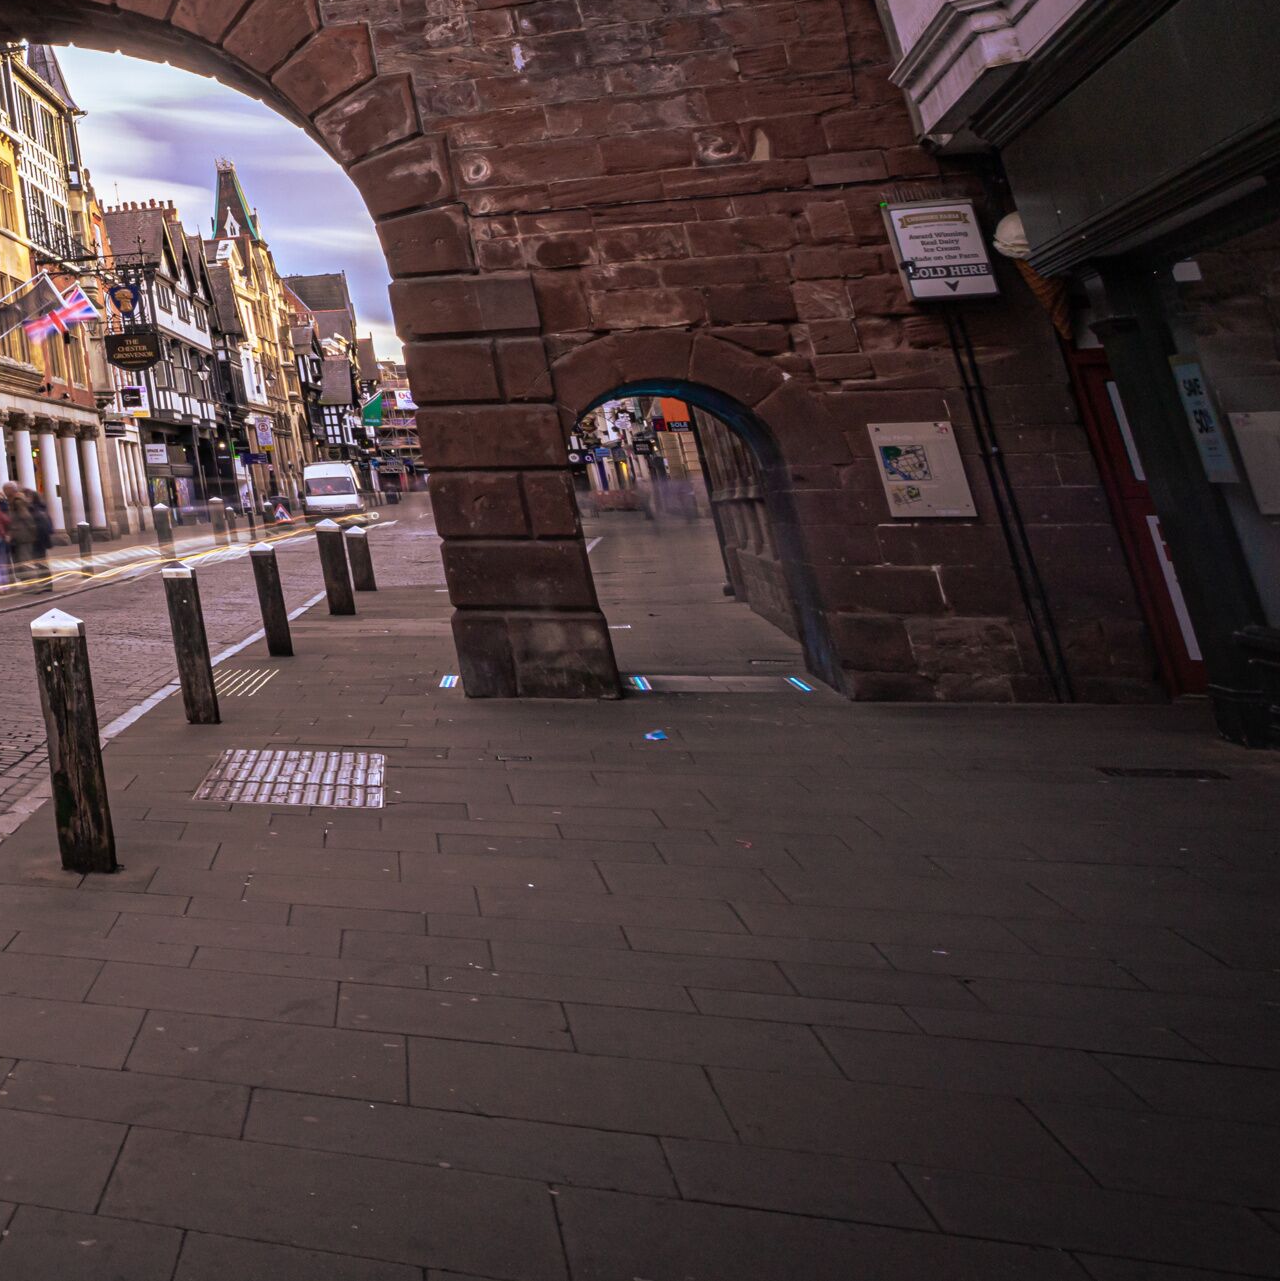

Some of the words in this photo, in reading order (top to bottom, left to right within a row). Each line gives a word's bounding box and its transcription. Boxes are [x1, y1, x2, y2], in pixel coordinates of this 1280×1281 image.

[935, 230, 968, 239] Winning
[939, 238, 960, 246] Dairy
[959, 252, 979, 260] Farm
[950, 263, 989, 277] HERE
[117, 344, 147, 353] CHESTER
